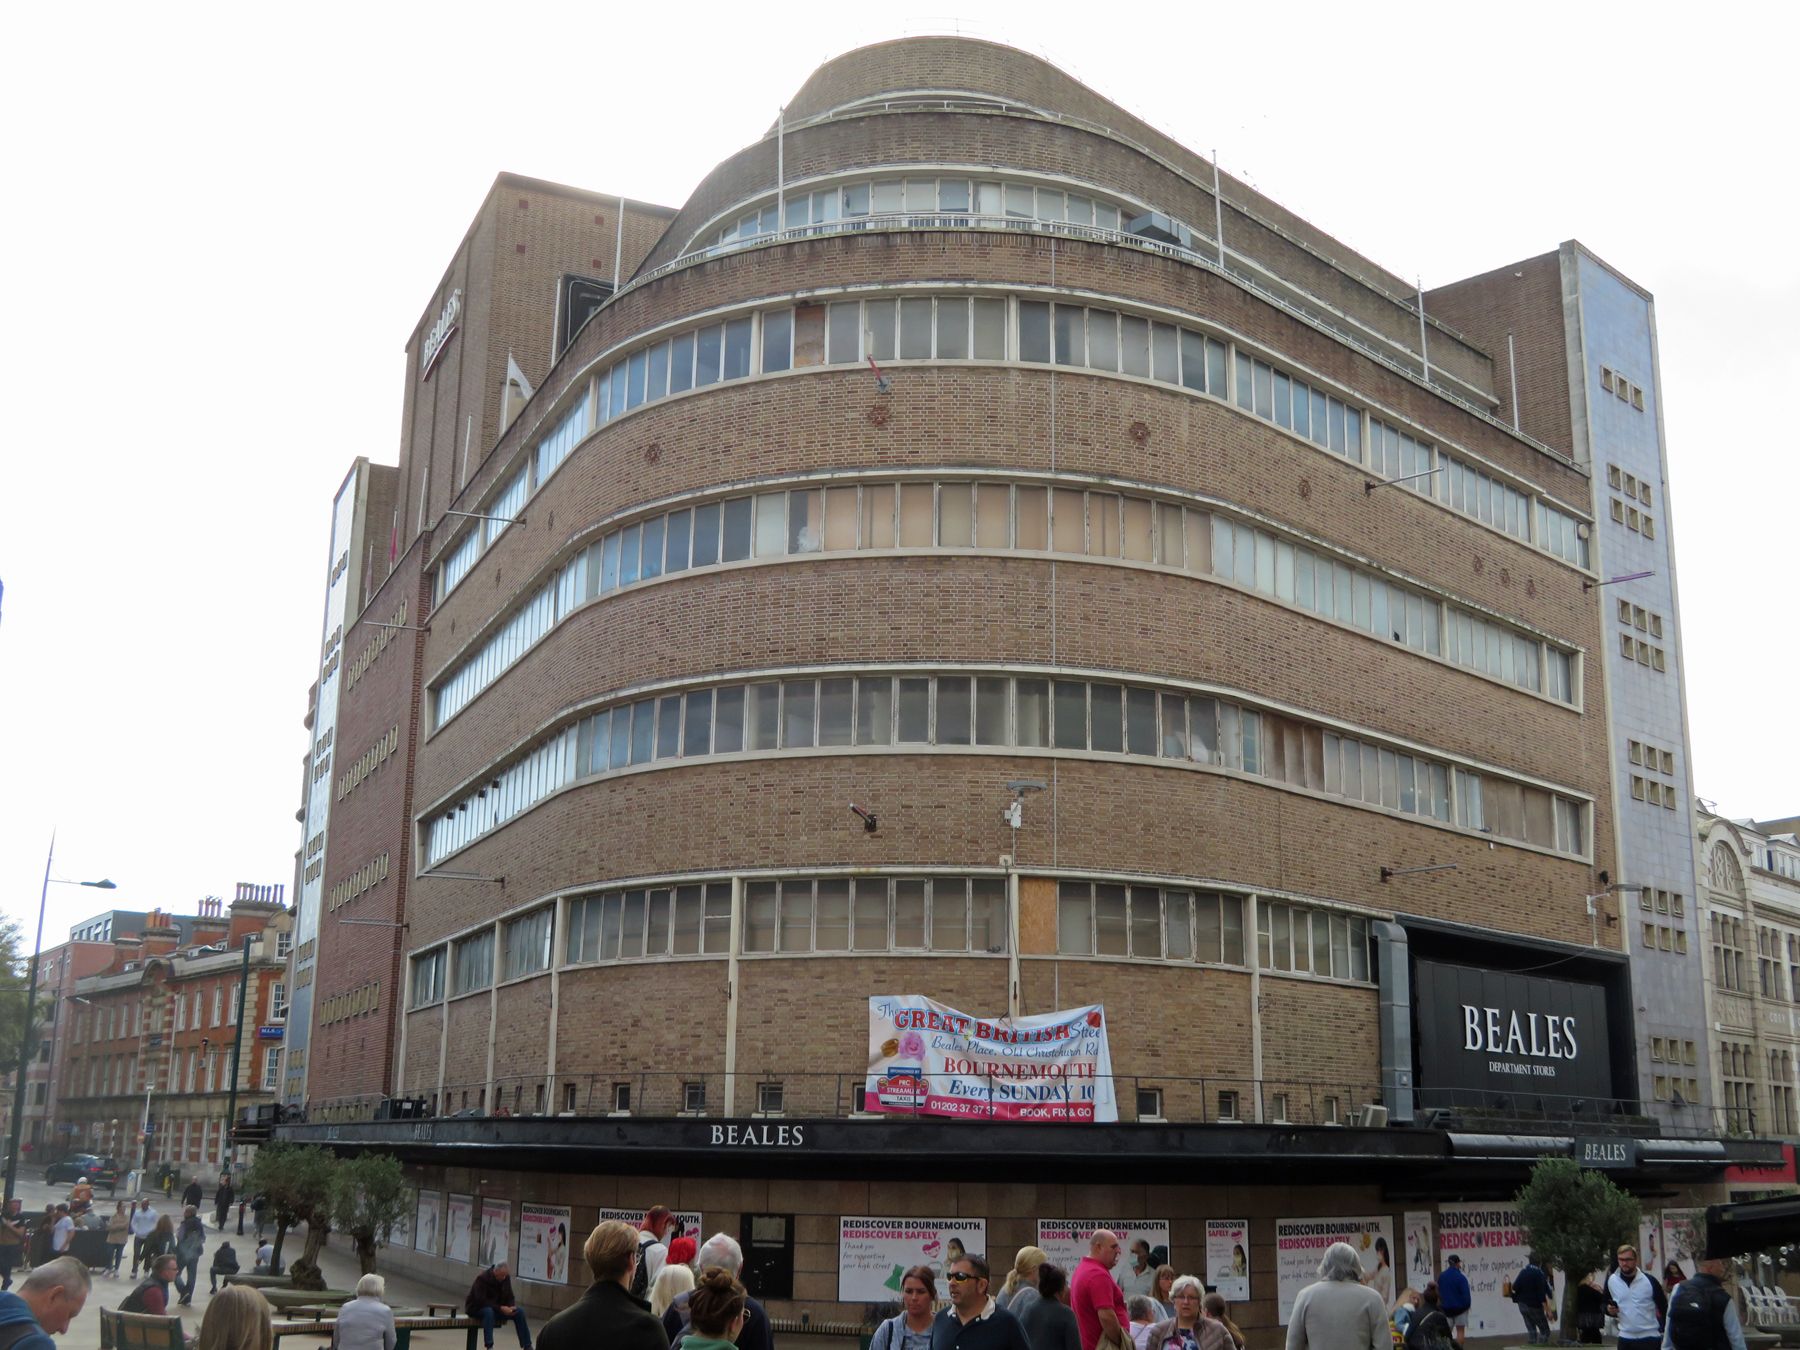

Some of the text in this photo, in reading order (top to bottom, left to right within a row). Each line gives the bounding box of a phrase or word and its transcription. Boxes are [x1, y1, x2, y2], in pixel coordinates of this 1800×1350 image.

[894, 1009, 970, 1034] GREAT
[975, 1021, 1070, 1044] BRITISH
[1462, 1004, 1577, 1060] BEALES
[931, 1035, 962, 1050] Beales
[1002, 1047, 1022, 1057] Old
[1026, 1043, 1081, 1058] Christchurch
[944, 1057, 1097, 1081] BOURNEMOUTH
[1489, 1061, 1556, 1077] DEPARTMENT STORES
[948, 1079, 995, 1101] Every
[1000, 1084, 1074, 1101] SUNDAY
[930, 1101, 997, 1115] 01202 37 37 37
[1053, 1108, 1067, 1117] FIX
[1069, 1108, 1075, 1117] &
[1077, 1108, 1092, 1117] GO
[710, 1124, 804, 1146] BEALES
[1584, 1143, 1626, 1161] BEALES
[601, 1211, 644, 1221] REDISCOVER
[1440, 1211, 1502, 1229] REDISCOVER
[843, 1220, 903, 1229] REDISCOVER
[1040, 1221, 1096, 1230] REDISCOVER
[1208, 1221, 1246, 1229] REDISCOVER
[1279, 1222, 1382, 1237] REDISCOVER BOURNEMUTH.
[843, 1230, 903, 1240] REDISCOVER
[1040, 1231, 1094, 1240] REDISCVE
[1440, 1231, 1503, 1250] REDISCVER
[1279, 1236, 1325, 1250] REDISCOVER
[857, 1263, 870, 1271] high
[1468, 1263, 1478, 1274] you
[1477, 1279, 1496, 1292] street
